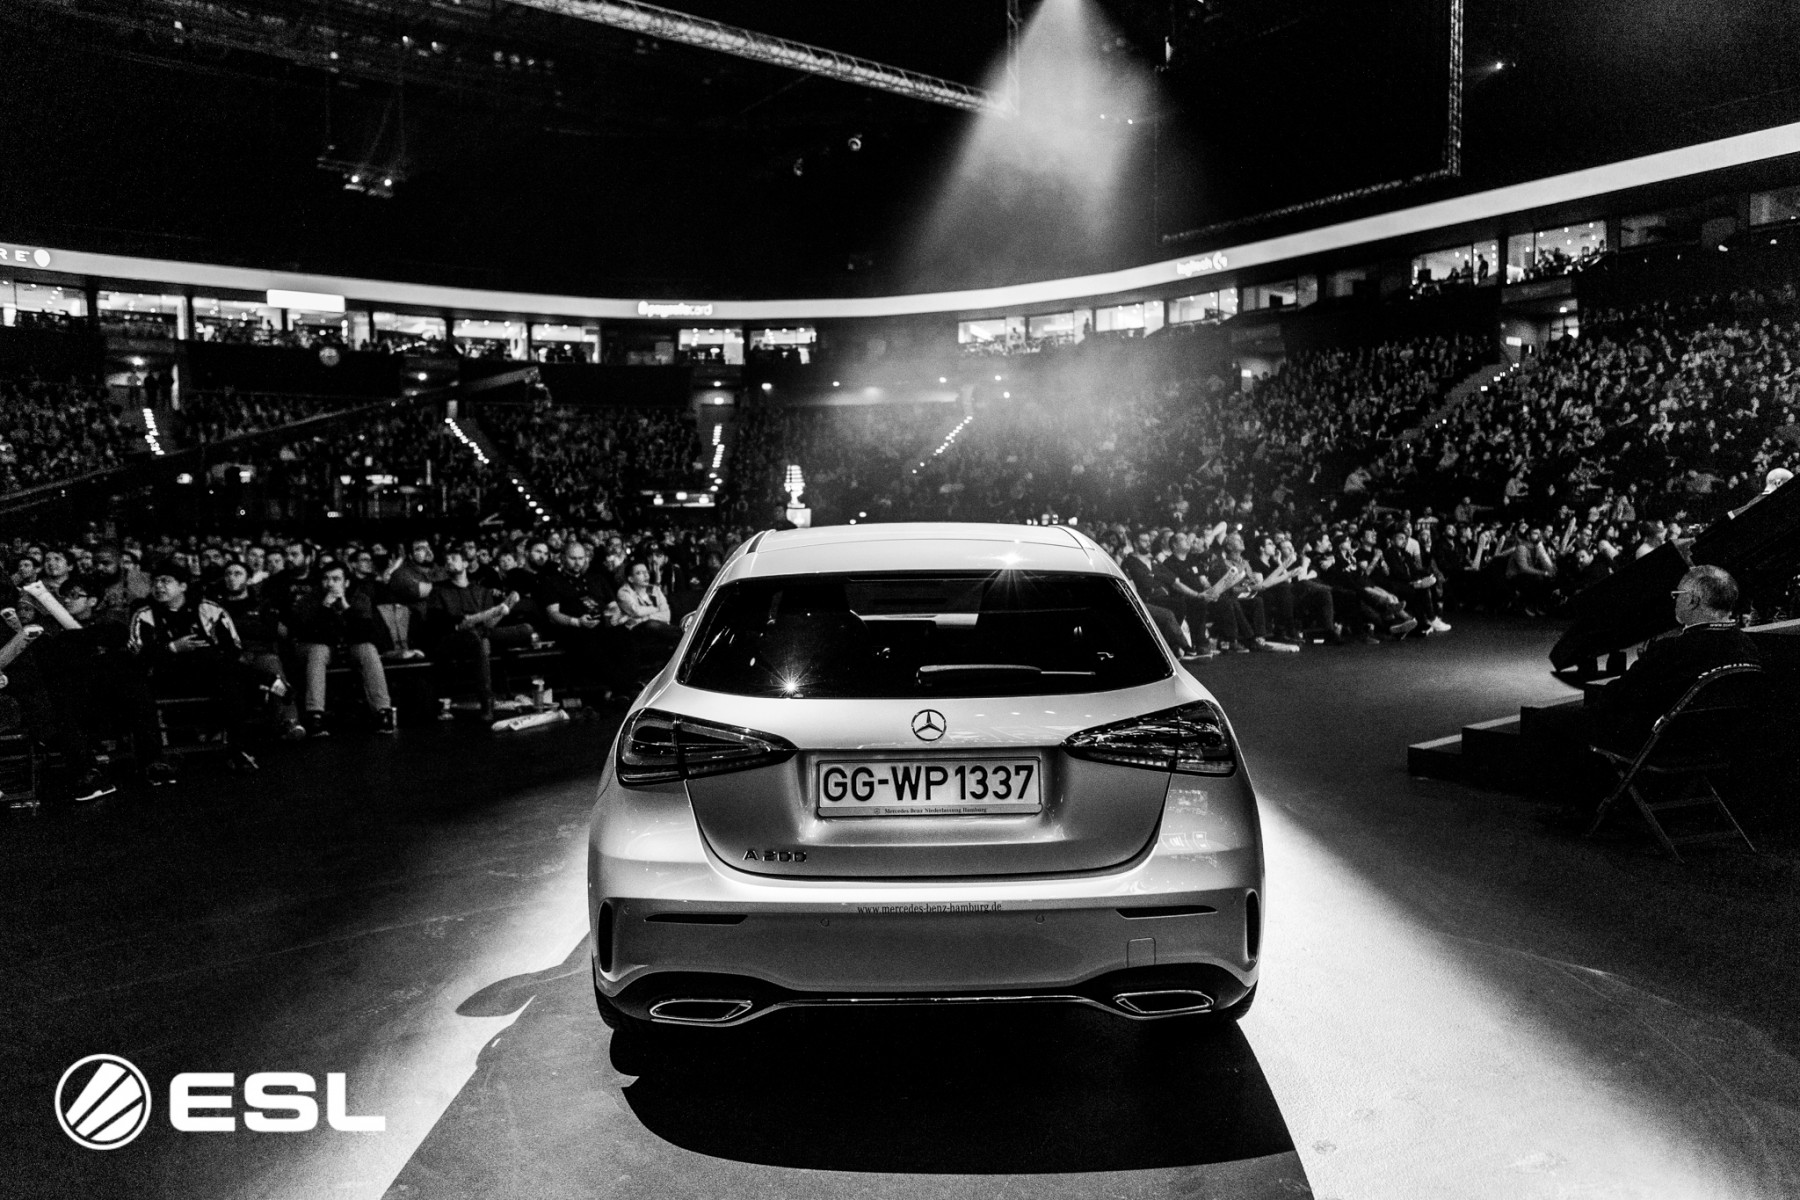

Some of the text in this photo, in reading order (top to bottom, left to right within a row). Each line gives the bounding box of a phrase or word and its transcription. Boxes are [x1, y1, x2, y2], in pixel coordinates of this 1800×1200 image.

[823, 765, 1034, 801] GG-WP 1337
[962, 806, 988, 814] Hamburg
[742, 850, 807, 862] A 200
[857, 901, 1002, 915] www.mercedes-benz-hamburg.de
